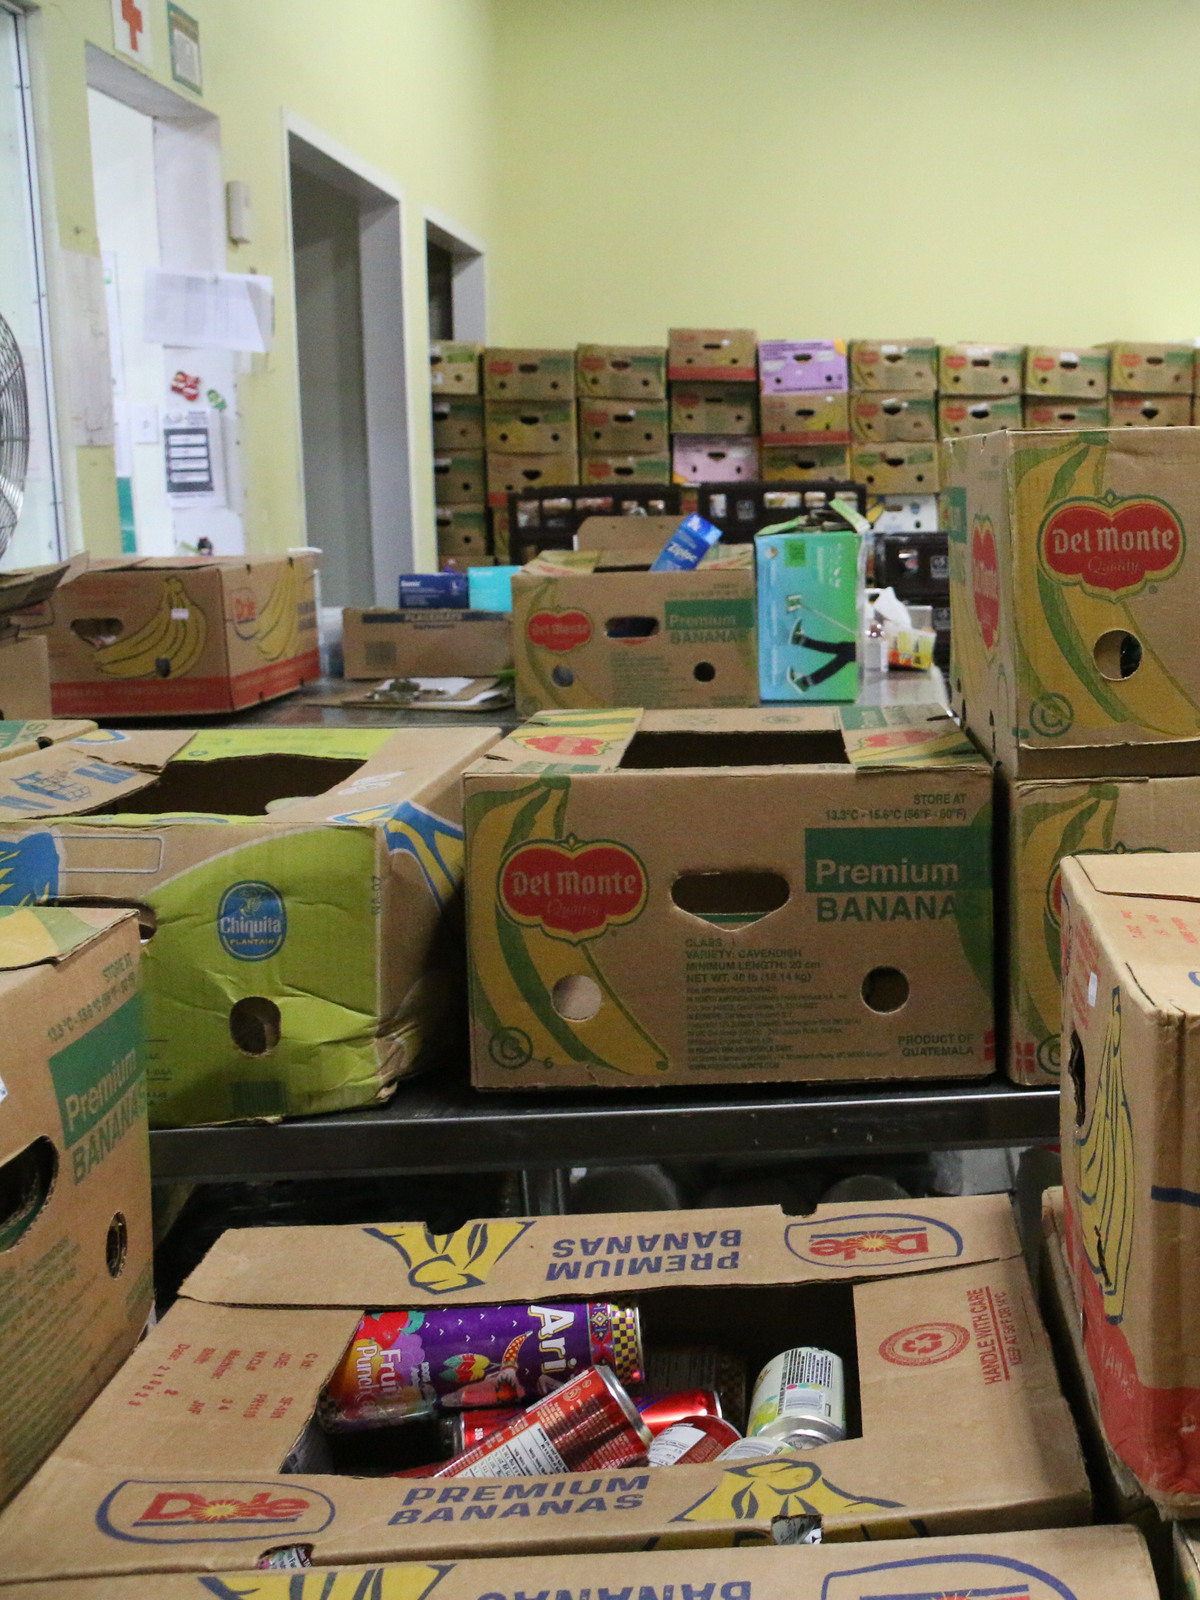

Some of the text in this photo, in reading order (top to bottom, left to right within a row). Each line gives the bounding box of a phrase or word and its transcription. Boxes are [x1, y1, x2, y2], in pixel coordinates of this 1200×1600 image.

[1053, 526, 1175, 555] Del Monte
[670, 630, 738, 644] BANANA
[913, 793, 967, 806] STORE AT
[511, 869, 636, 896] Del Monte
[816, 857, 959, 886] Premium
[220, 914, 283, 939] Chiquita
[686, 962, 736, 972] MINIMUM
[738, 961, 787, 971] LENGTH:
[686, 974, 707, 983] NET
[897, 1033, 974, 1047] PRODUCT OF
[902, 1045, 974, 1058] GUATEMALA
[64, 1047, 139, 1134] Premium
[552, 1228, 743, 1259] BANANAS
[811, 1232, 930, 1260] Dole
[546, 1250, 741, 1283] PREMIUM
[528, 1304, 578, 1374] Ari
[966, 1287, 1003, 1386] HANDLE WITH CARE
[380, 1348, 402, 1393] Frui
[402, 1474, 651, 1507] PREMIUM
[140, 1490, 311, 1521] Dole
[387, 1493, 645, 1528] BANANAS
